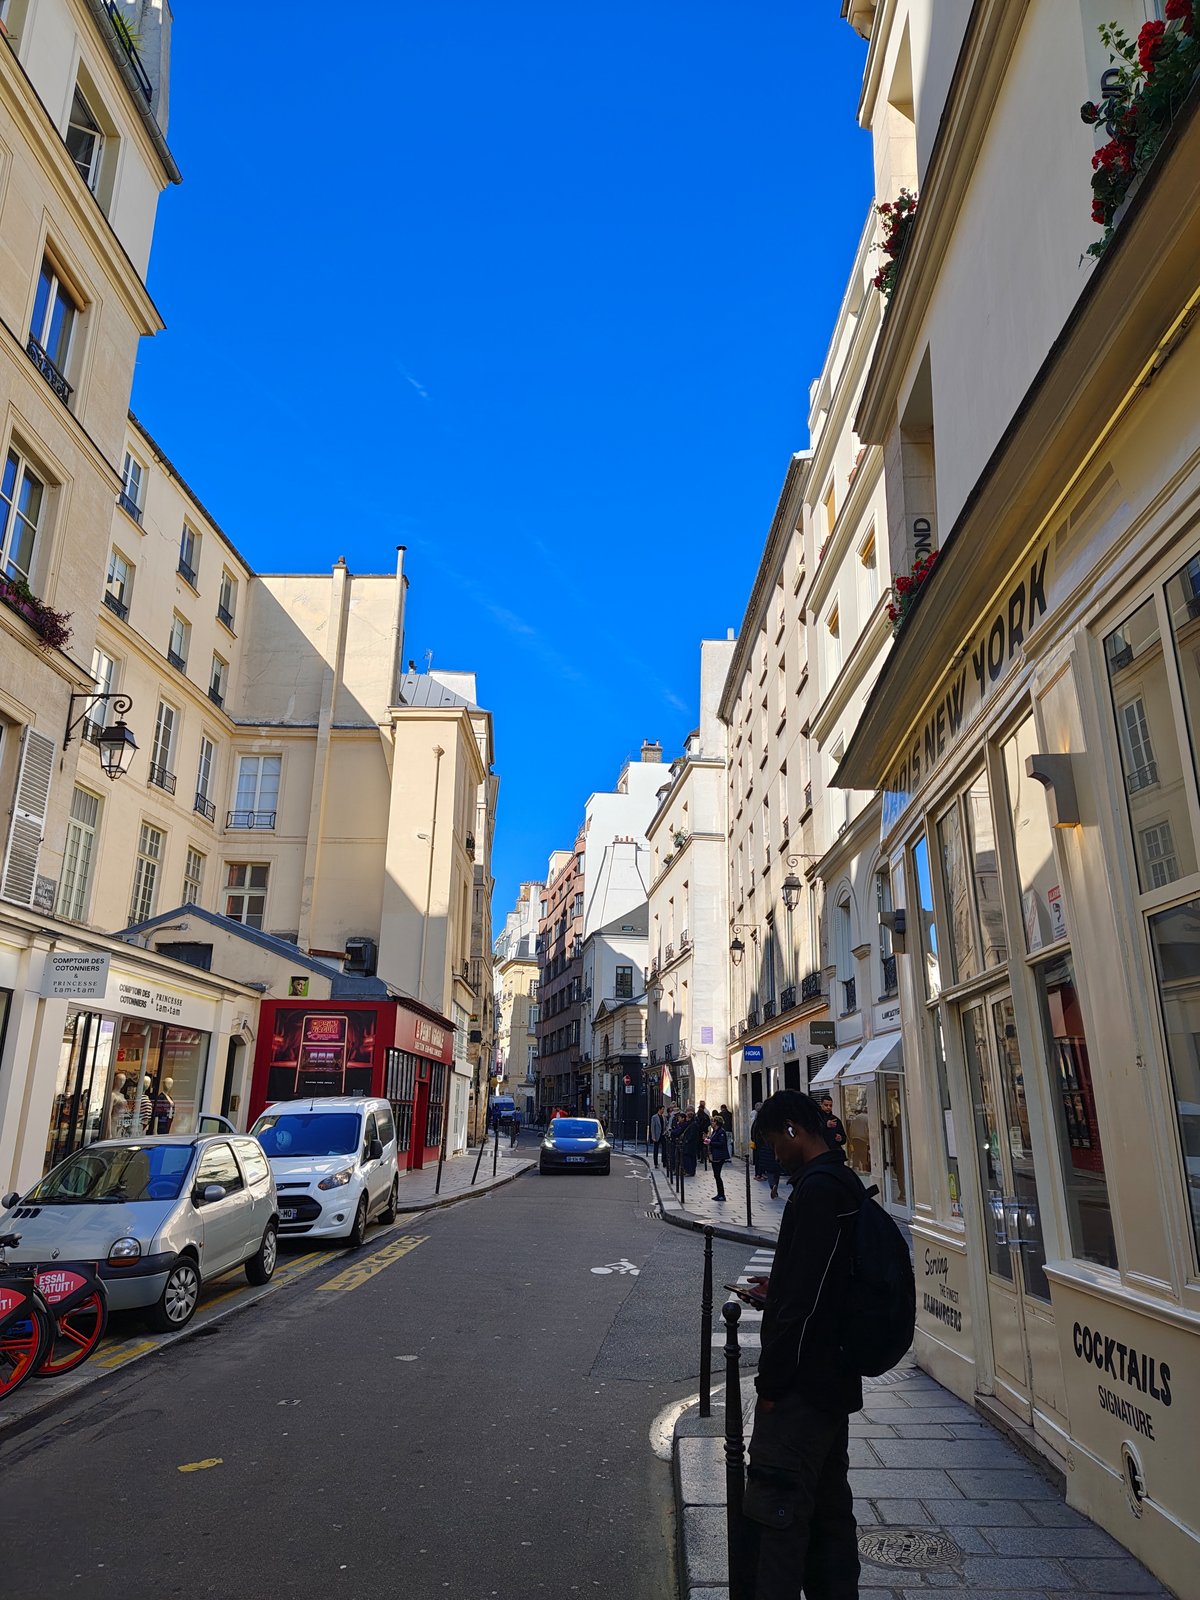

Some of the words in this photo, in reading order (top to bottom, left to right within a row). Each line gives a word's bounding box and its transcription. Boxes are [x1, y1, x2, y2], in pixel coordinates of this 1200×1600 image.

[924, 664, 967, 774] NEW
[972, 542, 1049, 699] YORK
[52, 957, 90, 965] COMPTOIR
[90, 957, 105, 965] DES
[118, 983, 142, 996] COMPTOIR
[141, 989, 151, 999] DES
[155, 993, 183, 1007] PRINCESSE
[119, 995, 147, 1008] COTONNIERS
[924, 1247, 949, 1285] Serving
[39, 1272, 66, 1285] ESSAI
[39, 1280, 75, 1294] RATUIT!
[938, 1282, 947, 1299] THE
[946, 1286, 960, 1305] FINEST
[923, 1292, 962, 1333] HAMBURGERS
[1073, 1321, 1172, 1407] COCKTAILS
[1098, 1384, 1156, 1441] SIGNATURE
